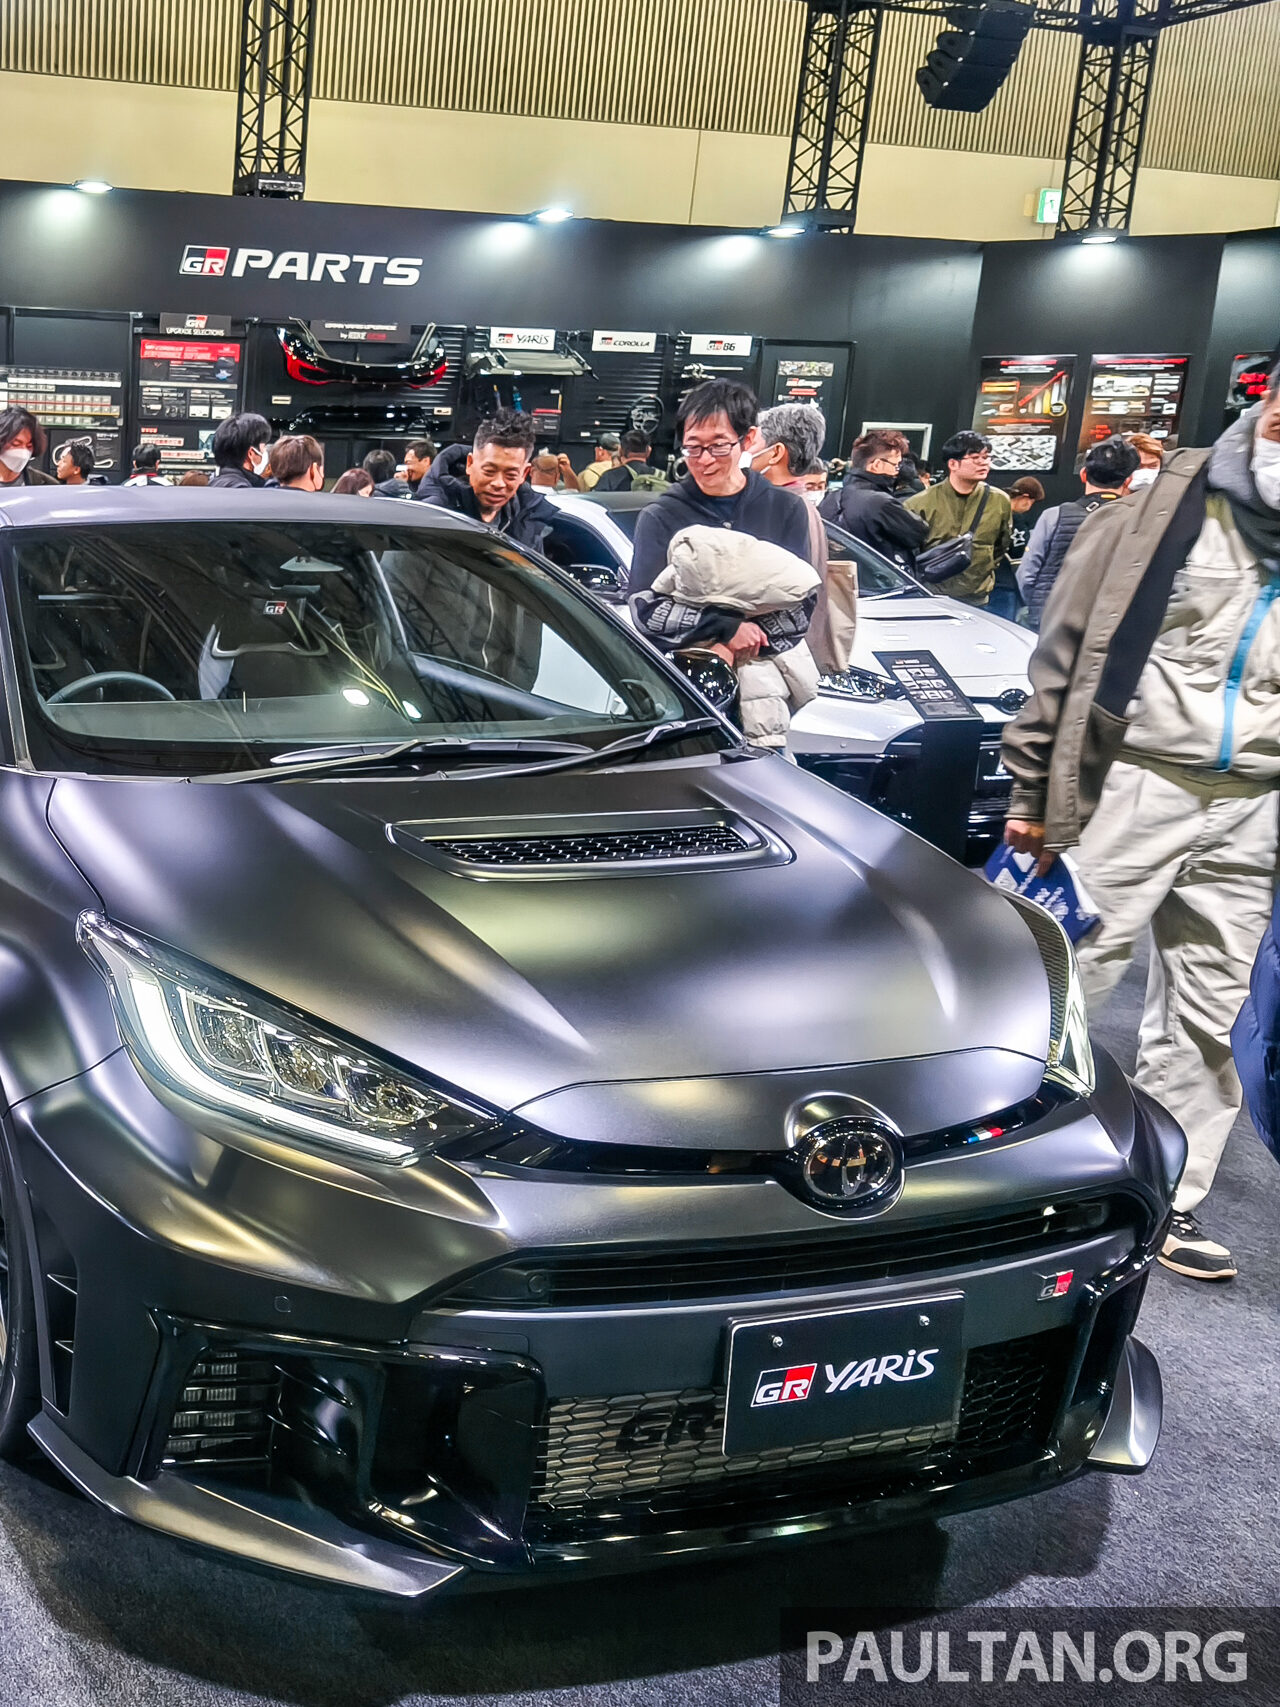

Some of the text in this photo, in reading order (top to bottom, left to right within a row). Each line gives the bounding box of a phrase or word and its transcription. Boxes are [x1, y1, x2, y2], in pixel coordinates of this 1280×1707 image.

[181, 247, 423, 286] GR PARTS
[515, 333, 550, 345] YARIS
[613, 339, 651, 347] COROLLA
[754, 1347, 941, 1403] GR YARIS
